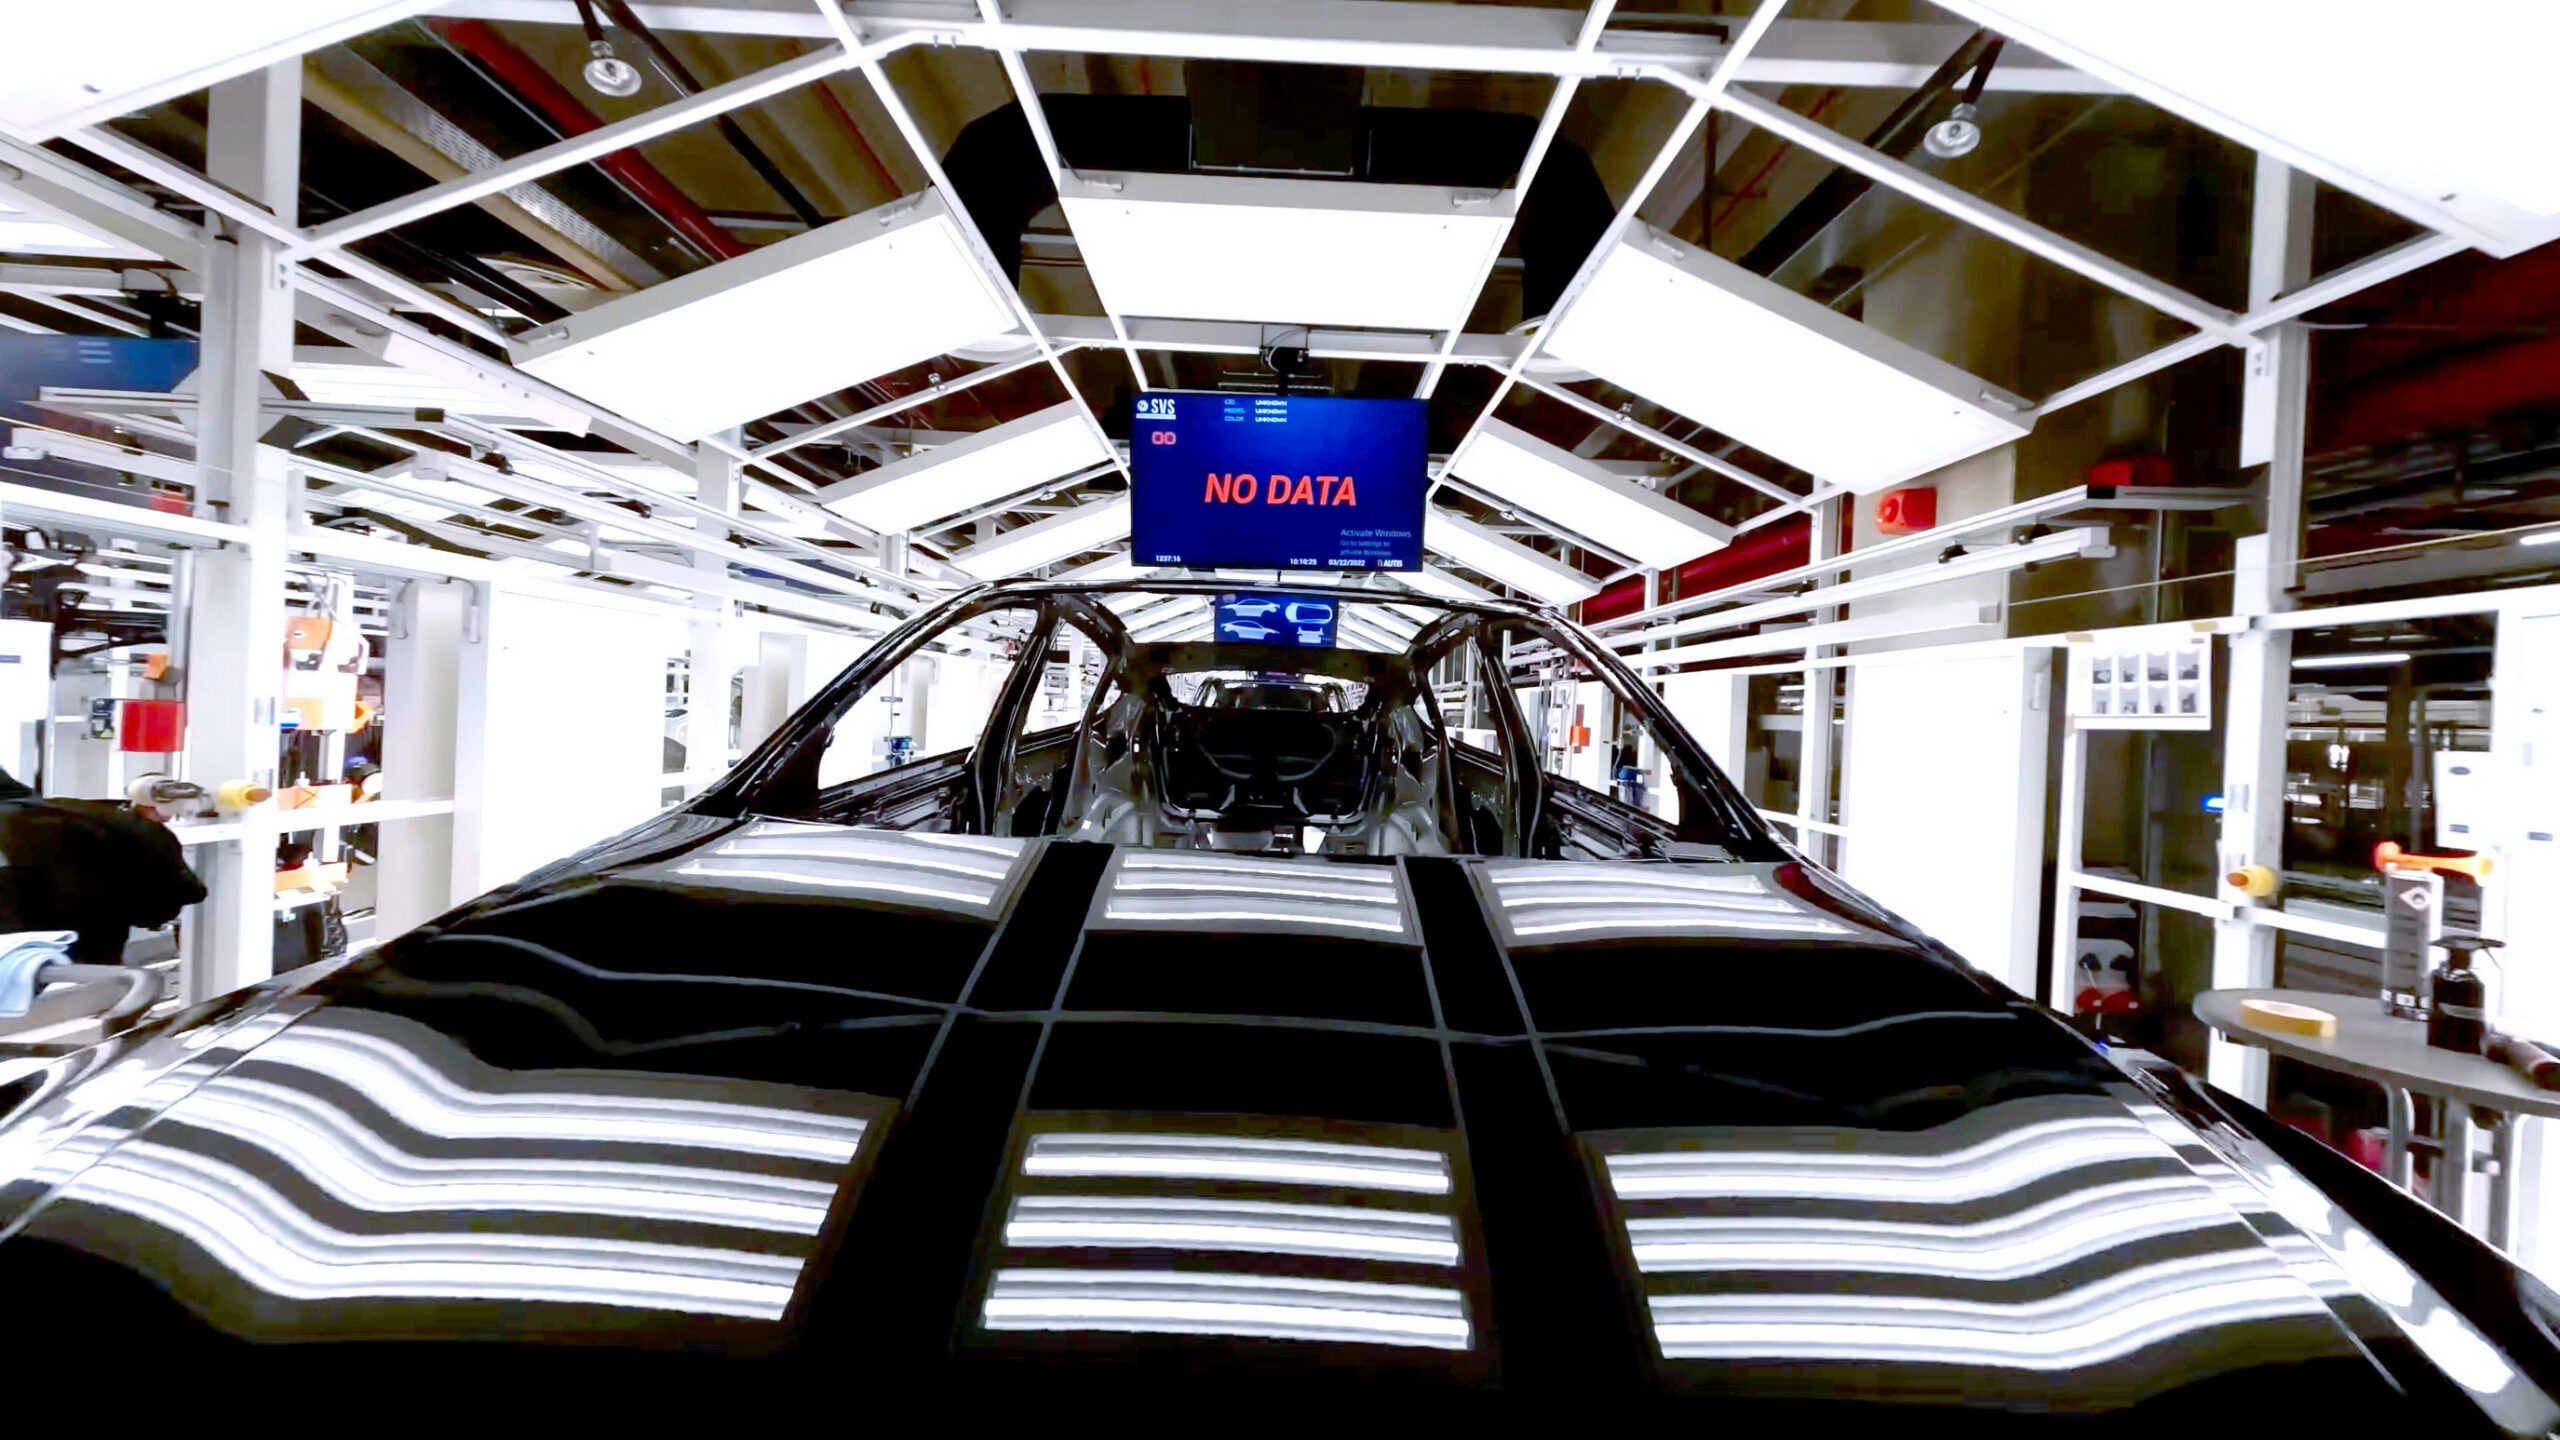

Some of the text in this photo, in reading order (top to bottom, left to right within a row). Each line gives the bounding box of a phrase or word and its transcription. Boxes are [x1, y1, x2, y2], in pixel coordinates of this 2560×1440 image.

[1151, 398, 1175, 414] SVS
[1204, 473, 1357, 506] NO DATA
[1340, 528, 1411, 538] Activate Windows
[1290, 558, 1317, 566] 10:10:29
[1328, 559, 1366, 567] 03/22/2022
